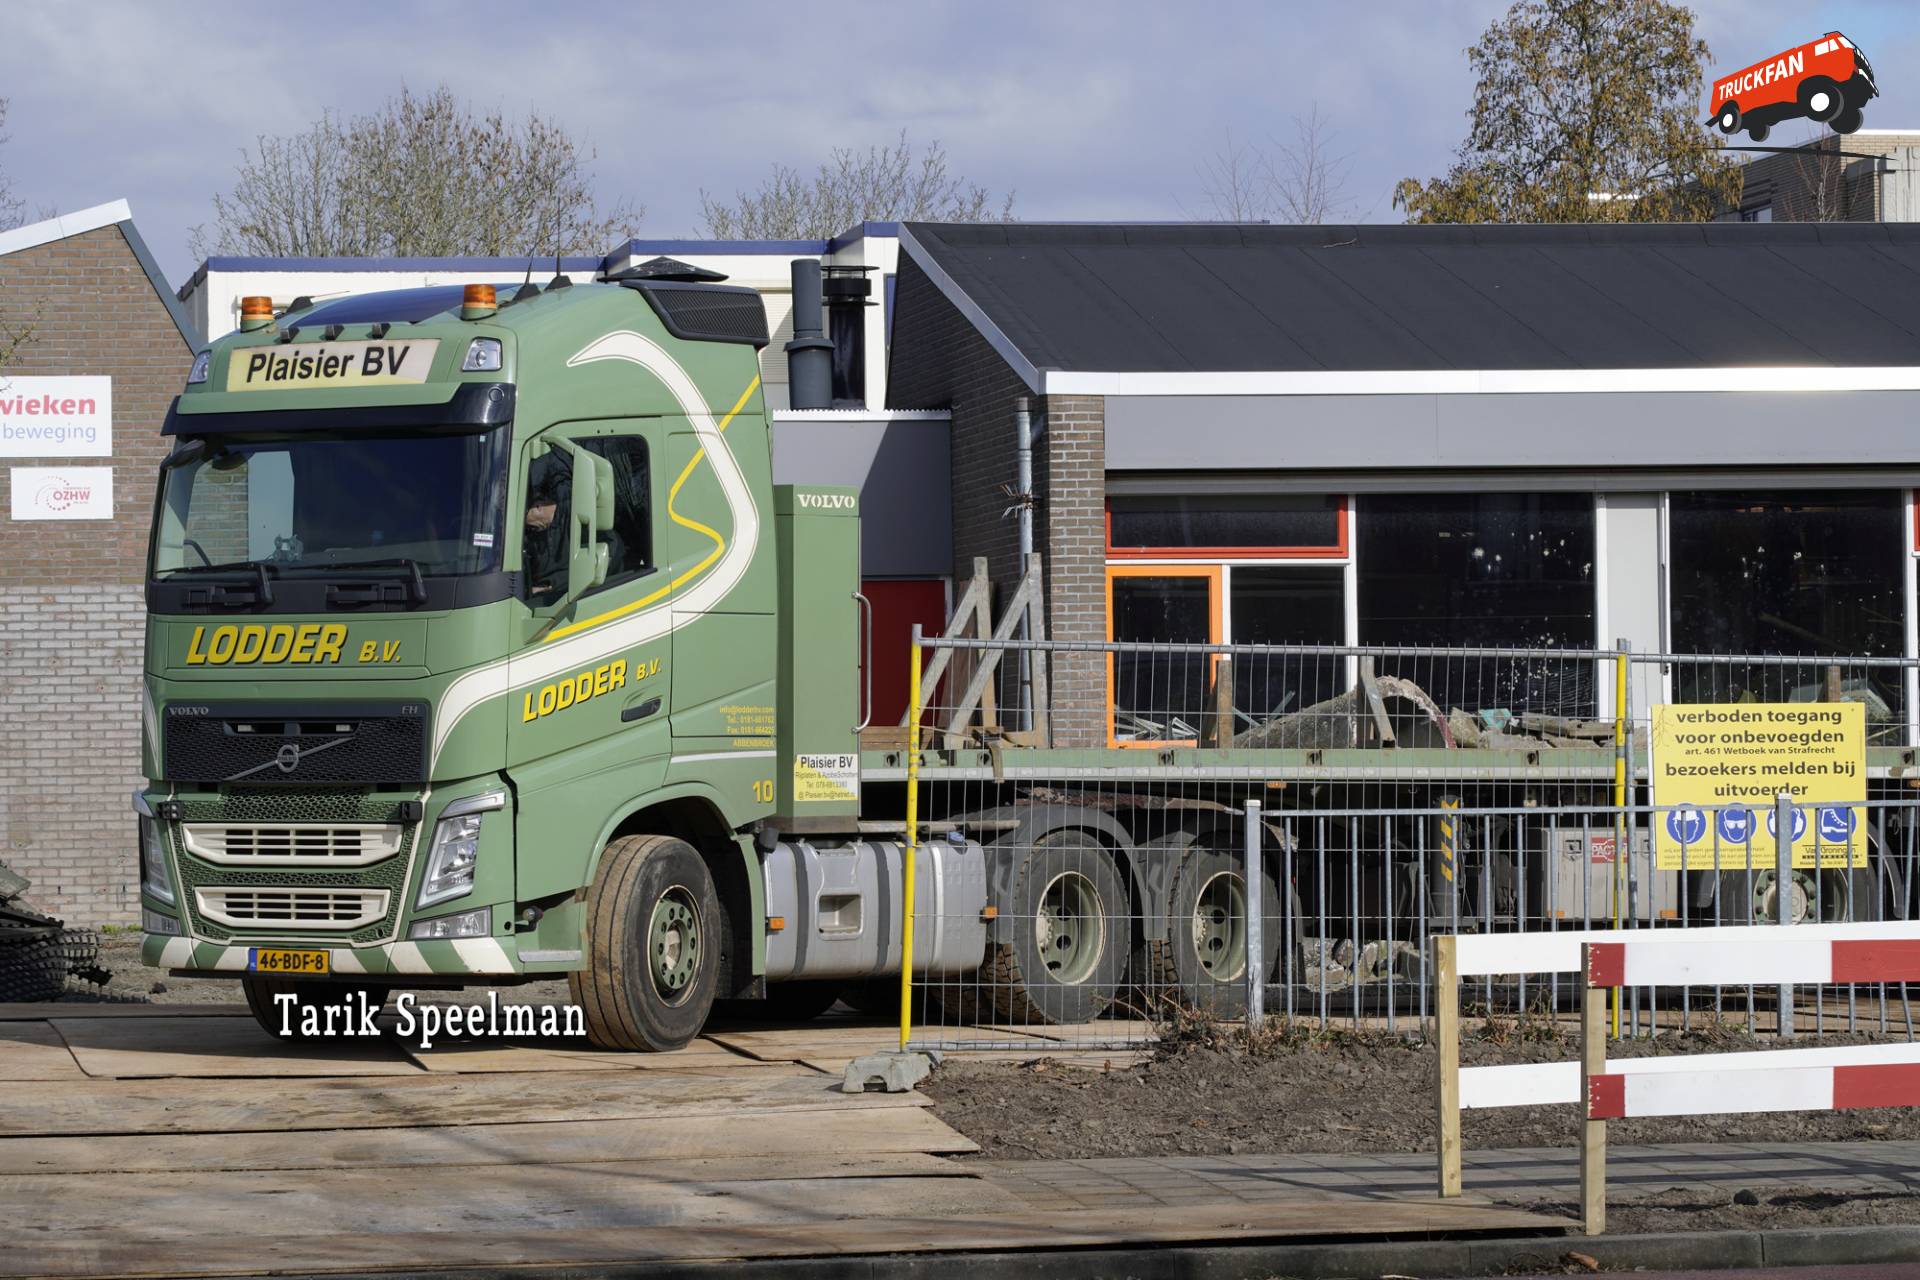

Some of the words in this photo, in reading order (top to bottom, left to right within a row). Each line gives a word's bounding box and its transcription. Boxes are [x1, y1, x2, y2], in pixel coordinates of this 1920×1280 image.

[246, 349, 354, 383] Plaisier
[361, 346, 410, 377] BV
[3, 422, 96, 443] beweging
[53, 490, 90, 501] OZHW
[797, 494, 856, 509] VOLVO
[186, 624, 348, 665] LODDER
[358, 640, 401, 663] B.V.
[522, 658, 628, 724] LODDER
[636, 657, 662, 682] B.V.
[169, 706, 209, 716] VOLVO
[401, 705, 418, 715] FH
[1676, 710, 1762, 723] verboden
[1767, 709, 1842, 725] toegang
[1675, 732, 1716, 744] voor
[1720, 730, 1844, 746] onbevoegden
[1704, 747, 1721, 755] 461
[1723, 747, 1766, 755] Wetboek
[1788, 746, 1836, 755] Strafrecht
[800, 755, 836, 769] Plaisier
[839, 755, 854, 769] BV
[1665, 763, 1757, 776] bezoekers
[1761, 762, 1828, 775] melden
[1833, 761, 1855, 777] bij
[753, 779, 774, 804] 10
[1714, 782, 1809, 797] uitvoerder
[260, 952, 323, 970] 46-BDF-8
